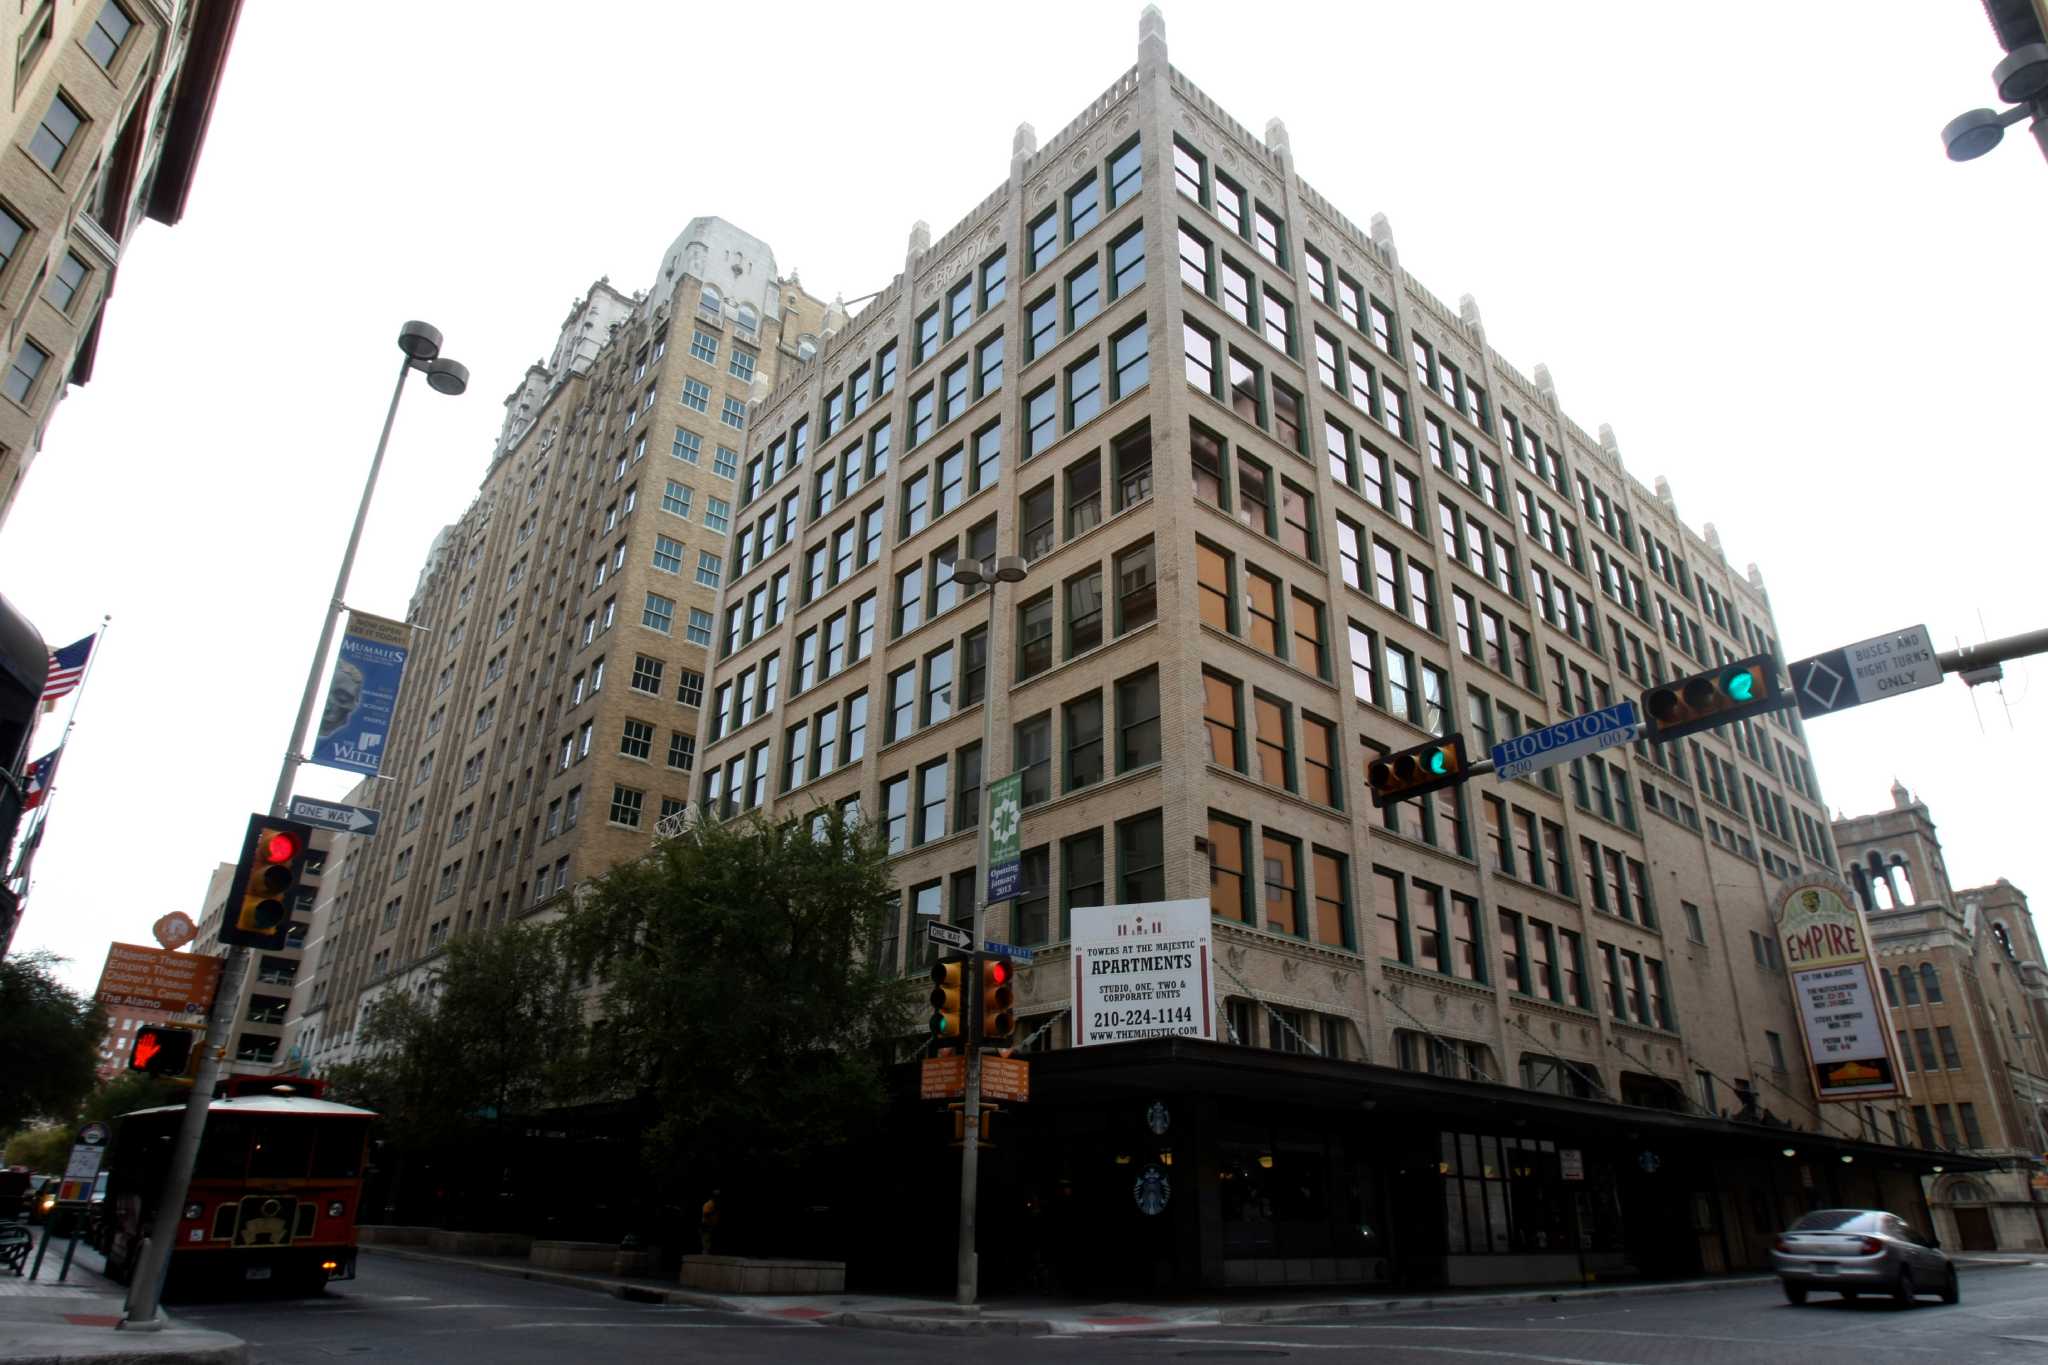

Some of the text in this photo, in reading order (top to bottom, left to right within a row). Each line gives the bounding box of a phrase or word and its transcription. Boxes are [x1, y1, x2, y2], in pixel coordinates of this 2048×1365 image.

[934, 231, 989, 292] BRADY
[342, 639, 404, 663] MUMMIES
[1855, 634, 1919, 661] BUSES AND
[1857, 649, 1929, 679] RIGHT TURNS
[1877, 670, 1917, 690] ONLY
[1502, 707, 1621, 763] HOUSTON
[1599, 732, 1621, 748] 100
[333, 742, 381, 765] WITTE
[1511, 759, 1532, 776] 200
[298, 804, 354, 823] ONE WAY
[990, 863, 1018, 880] Opening
[991, 874, 1016, 889] January
[932, 927, 961, 943] ONE WAY
[1786, 923, 1860, 962] EMPIRE
[1087, 940, 1195, 957] TOWERS AT THE MAJESTIC
[109, 959, 193, 978] Empire Theater
[159, 954, 198, 967] Theater
[1091, 954, 1192, 976] APARTMENTS
[1099, 980, 1186, 995] STUDIO, ONE, TWO &
[1103, 989, 1181, 1003] CORPORATE UNITS
[99, 992, 161, 1009] The Alamo
[1094, 1006, 1192, 1028] 210-224-1144
